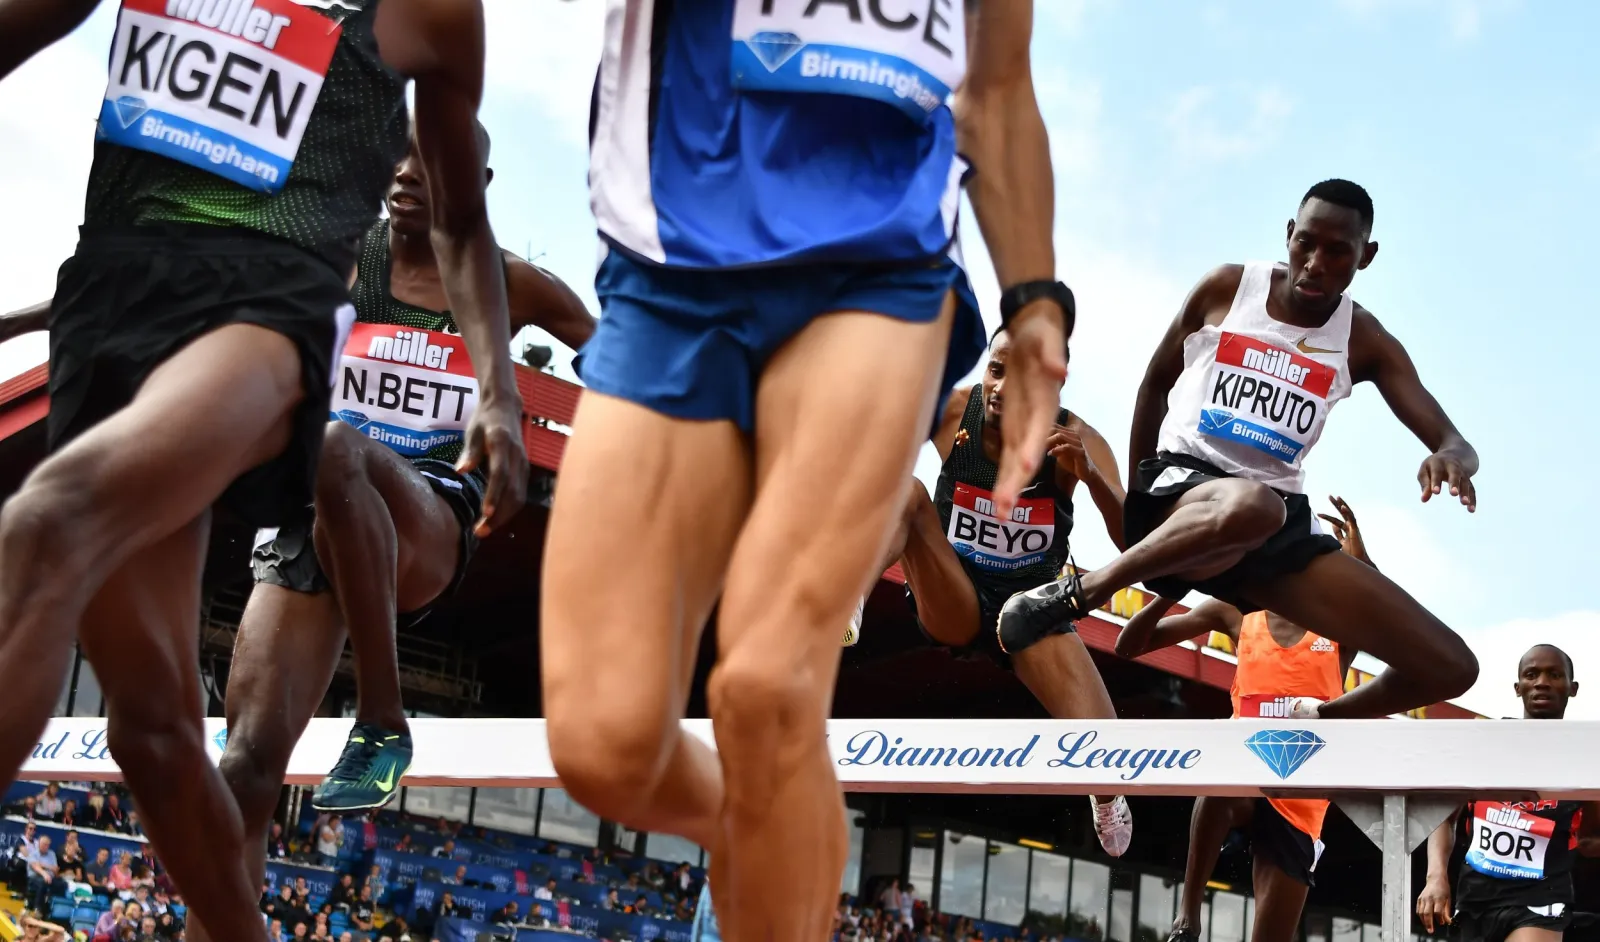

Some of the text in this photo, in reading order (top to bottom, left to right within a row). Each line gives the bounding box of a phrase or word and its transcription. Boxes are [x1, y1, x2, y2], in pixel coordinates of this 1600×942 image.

[119, 25, 307, 140] KIGEN
[801, 51, 941, 113] Birmingham
[140, 116, 280, 184] Birmingham
[367, 330, 454, 371] müller
[1242, 347, 1311, 387] müller
[342, 366, 474, 422] N.BETT
[1211, 370, 1317, 435] KIPRUTO
[369, 425, 459, 451] Birmingham
[1231, 422, 1298, 456] Birmingham
[974, 496, 1033, 524] mer
[954, 511, 1048, 553] BEYO
[974, 554, 1042, 570] Birmingham
[1259, 696, 1294, 719] mül
[837, 729, 1202, 781] Diamond League
[1485, 806, 1535, 831] müller
[1479, 825, 1536, 862] BOR
[1481, 860, 1540, 879] Birmingham
